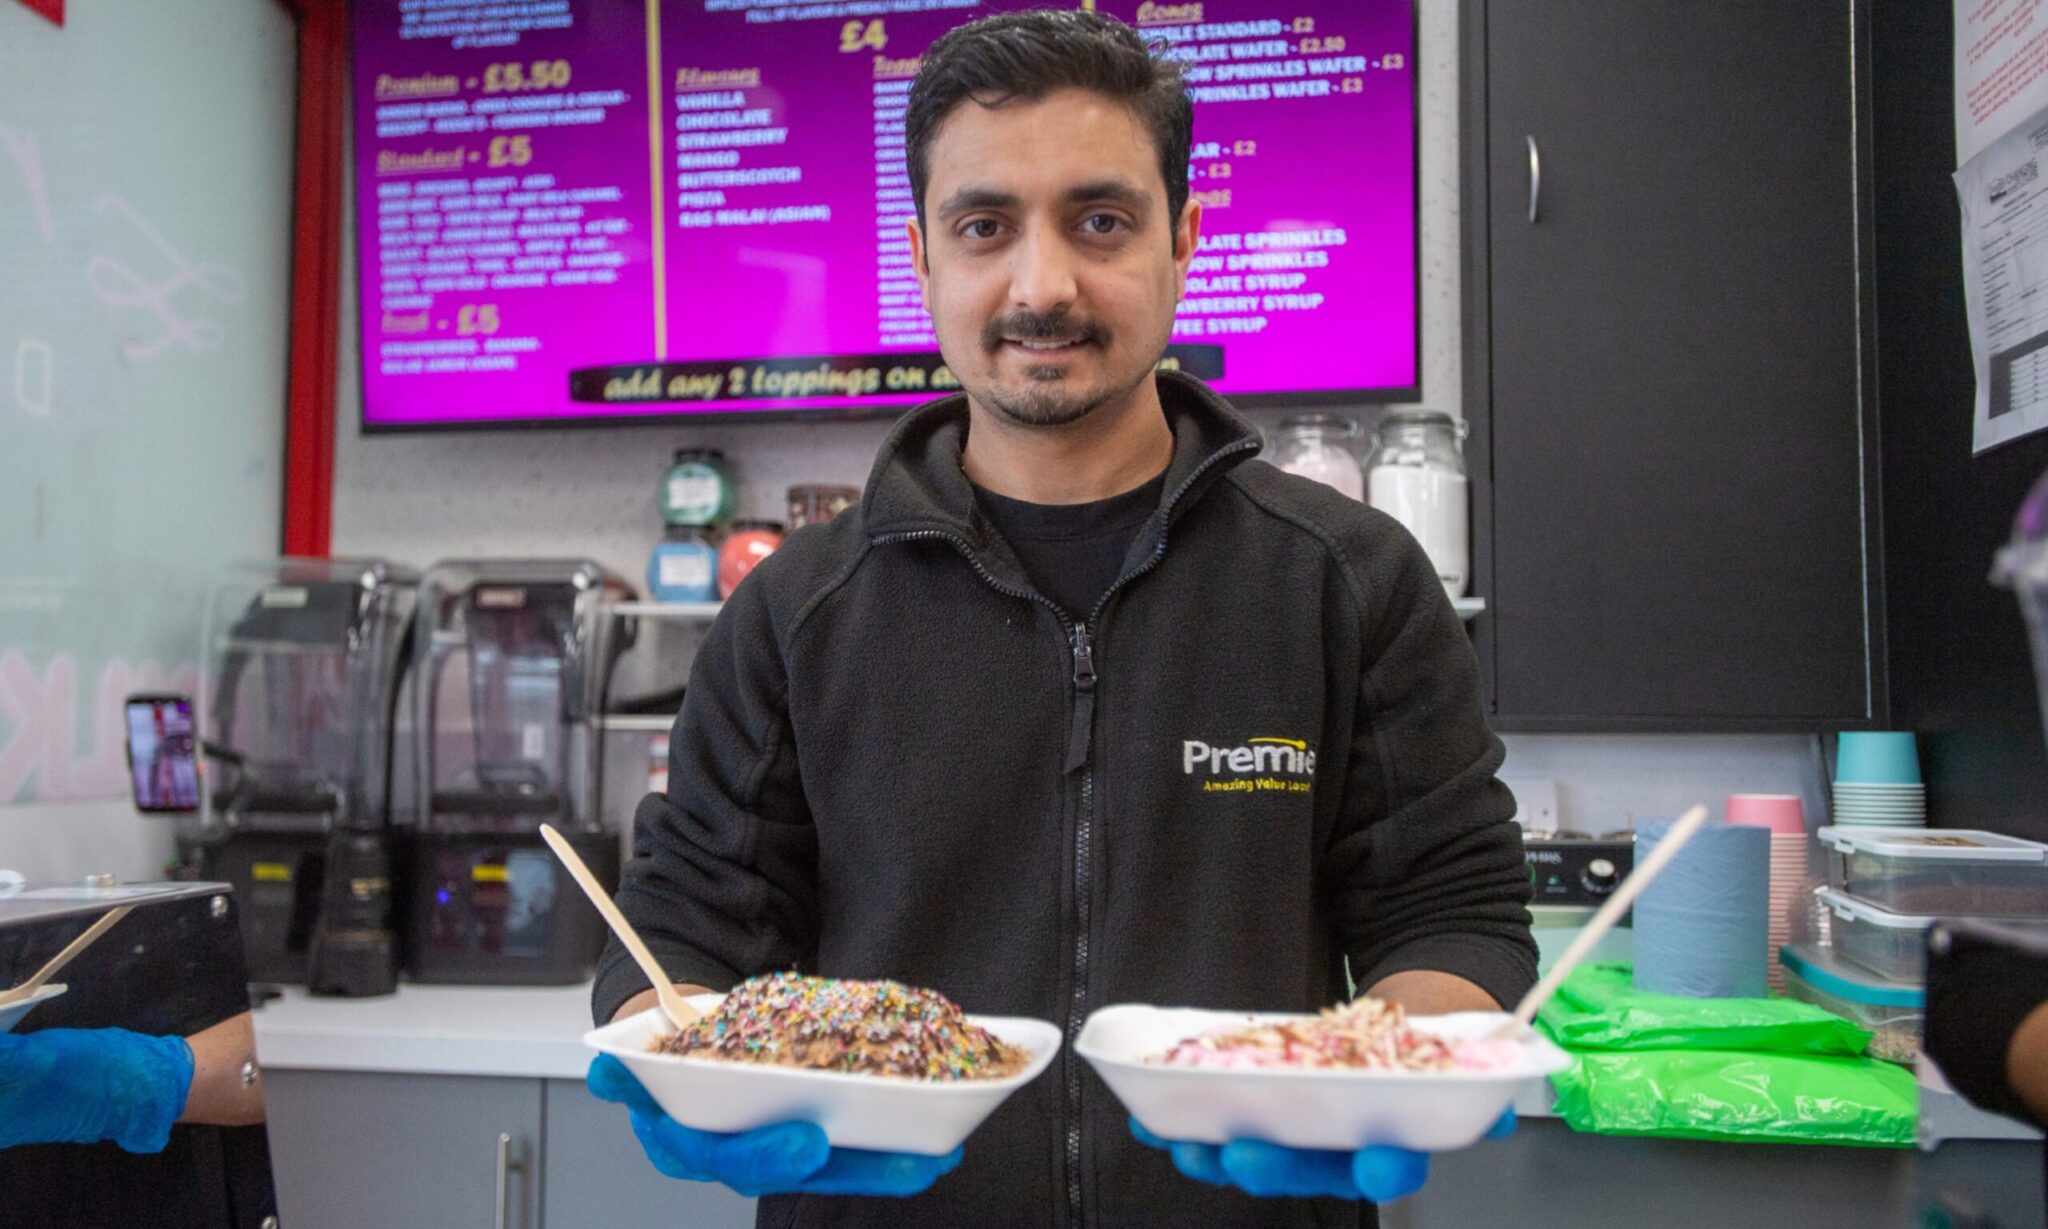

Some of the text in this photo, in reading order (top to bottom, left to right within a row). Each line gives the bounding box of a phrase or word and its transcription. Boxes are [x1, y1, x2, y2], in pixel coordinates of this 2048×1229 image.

[838, 19, 888, 53] £4
[1195, 19, 1282, 41] STANDARD
[1230, 40, 1288, 58] WAFER
[483, 59, 571, 94] £5.50
[1215, 60, 1306, 81] SPRINKLES
[1307, 56, 1367, 75] WAFER
[1271, 79, 1330, 98] WAFER
[676, 90, 746, 111] VANILLA
[676, 108, 773, 132] CHOCOLATE
[676, 127, 788, 151] STRAWBERRY
[487, 134, 533, 168] £5
[677, 150, 740, 170] MANGO
[677, 166, 801, 190] BUTTERSCOTCH
[1244, 228, 1347, 249] SPRINKLES
[1226, 250, 1329, 271] SPRINKLES
[1244, 272, 1306, 292] SYRUP
[1263, 292, 1324, 312] SYRUP
[456, 303, 500, 336] £5
[1206, 316, 1268, 335] SYRUP
[603, 368, 662, 400] add
[667, 371, 724, 400] any
[727, 367, 747, 395] 2
[750, 363, 881, 397] toppings
[885, 366, 926, 390] on
[1203, 779, 1254, 792] Amazing
[1255, 778, 1286, 790] Value
